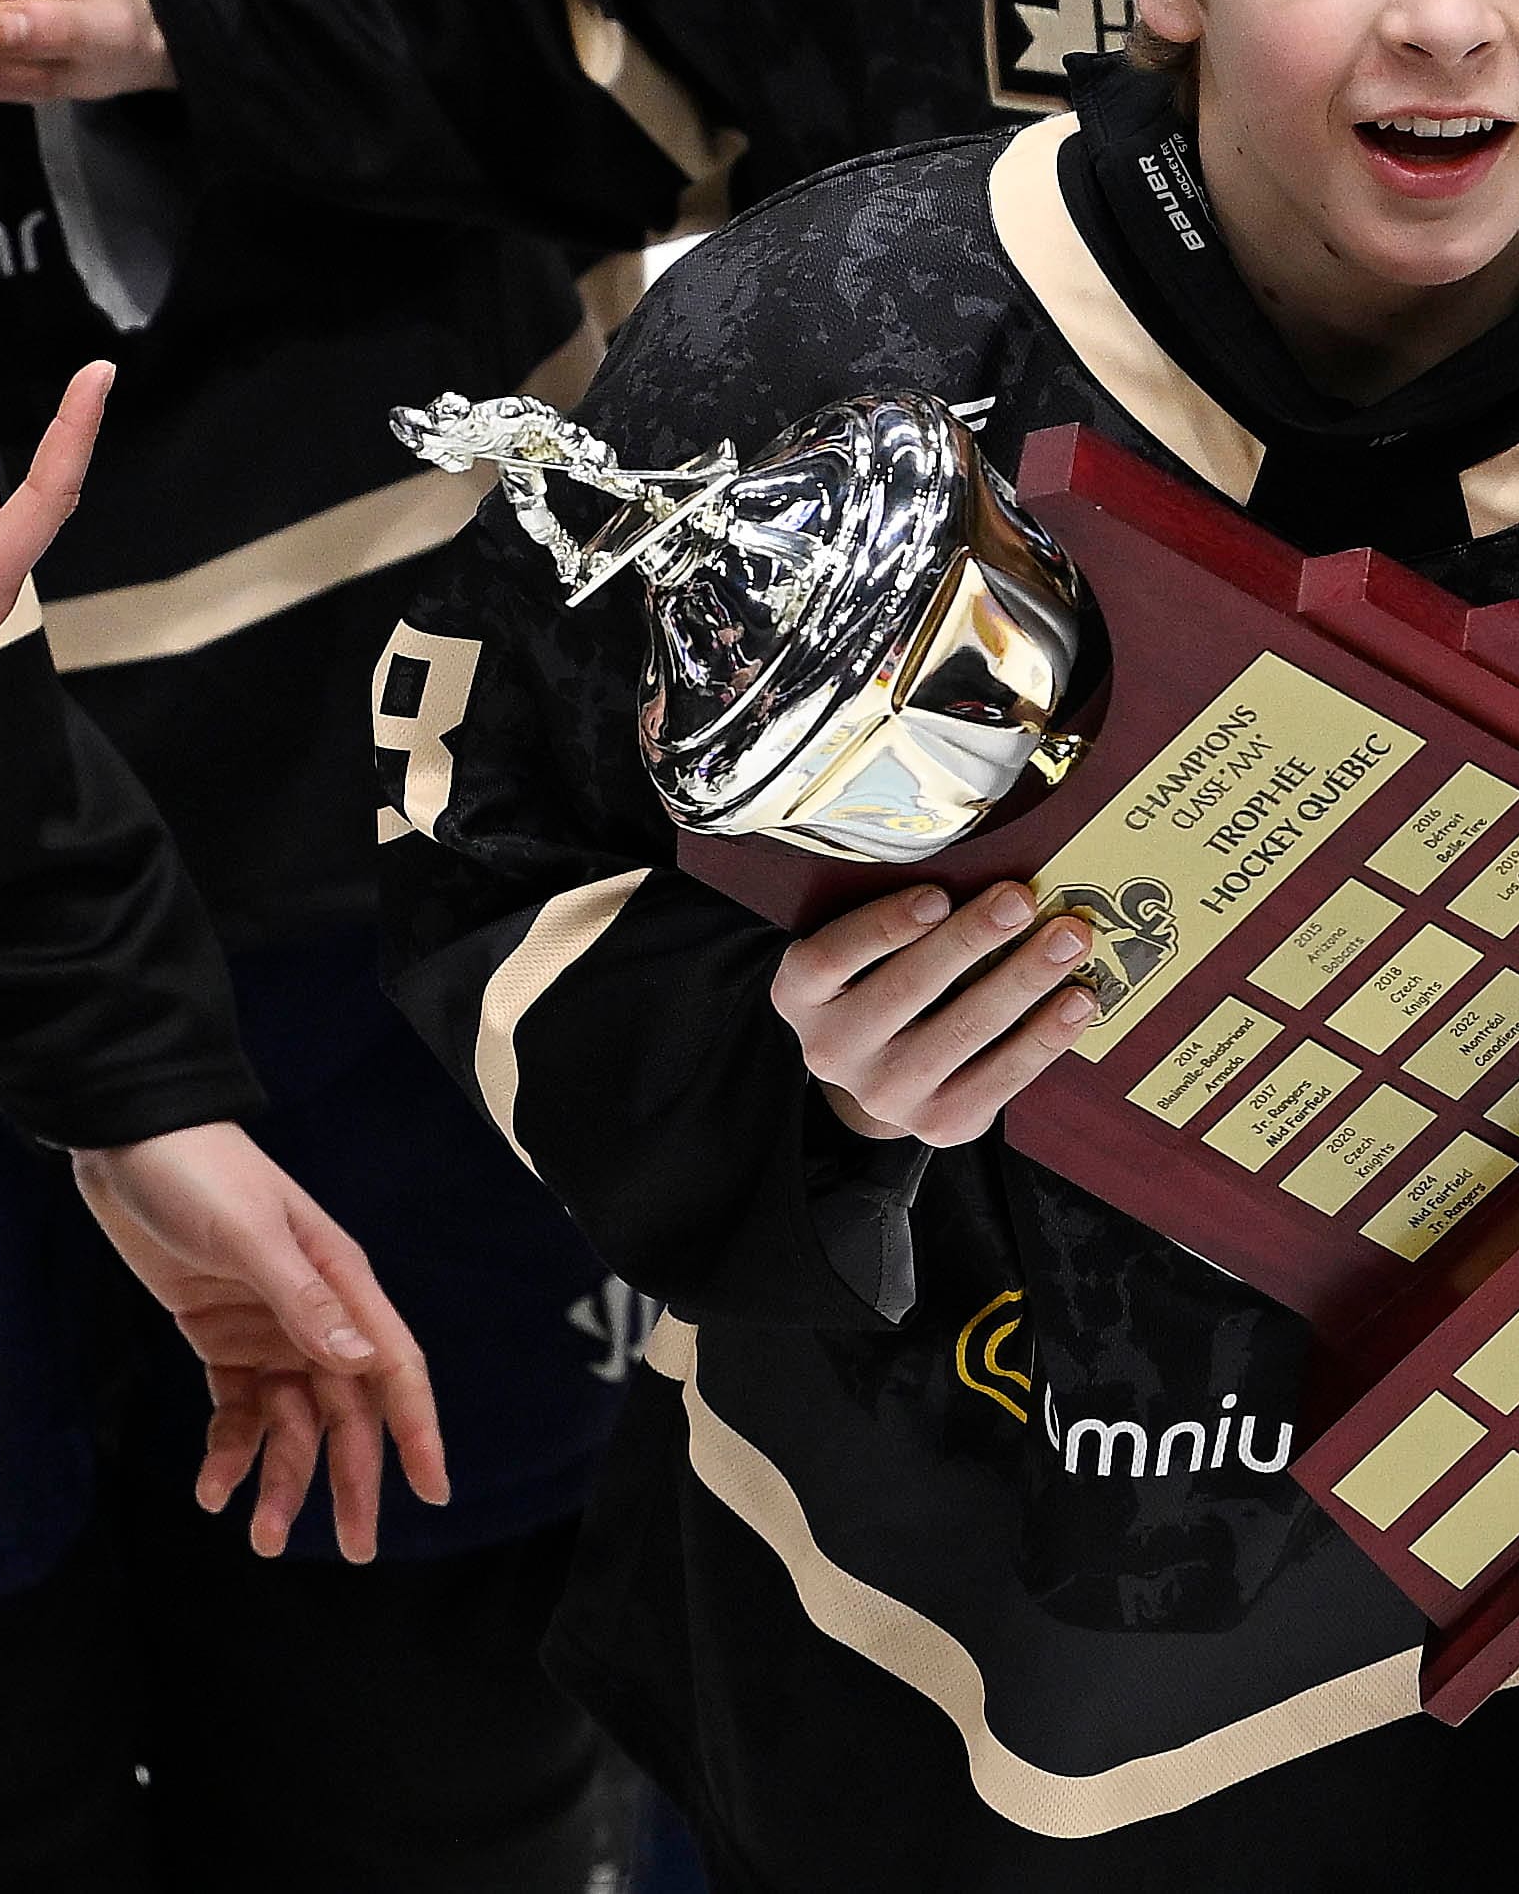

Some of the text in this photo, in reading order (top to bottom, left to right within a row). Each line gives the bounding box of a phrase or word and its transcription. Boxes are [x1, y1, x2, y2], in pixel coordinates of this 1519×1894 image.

[1139, 155, 1205, 251] BAUER
[1124, 704, 1257, 830] CHAMPIONS
[1171, 776, 1232, 829] CLASSE
[1203, 756, 1316, 855] TROPHÉE
[1412, 807, 1442, 834] 2016
[1199, 733, 1392, 914] HOCKEY QUÉBEC
[1423, 812, 1465, 849] Détroit
[1436, 817, 1488, 864] Belle Tire
[1293, 922, 1322, 949] 2015
[1306, 926, 1348, 965] Arizona
[1320, 936, 1366, 974] Bobcats
[1373, 966, 1402, 992] 2018
[1389, 974, 1423, 1004] Czech
[1401, 980, 1443, 1017] Knights
[1449, 1011, 1480, 1038] 2022
[1458, 1013, 1507, 1057] Montréal
[1156, 1017, 1256, 1110] Blainville-Boisbriand
[1173, 1041, 1203, 1067] 2014
[1203, 1055, 1245, 1094] Armada
[1249, 1083, 1278, 1110] 2017
[1250, 1079, 1312, 1136] Jr. Rangers
[1265, 1086, 1332, 1148] Mid Fairfield
[1326, 1126, 1357, 1155] 2020
[1343, 1135, 1376, 1165] Czech
[1354, 1141, 1396, 1179] Knights
[1407, 1174, 1438, 1203] 2024
[1407, 1168, 1474, 1229] Mid Fairfield
[1427, 1182, 1486, 1236] Jr. Rangers
